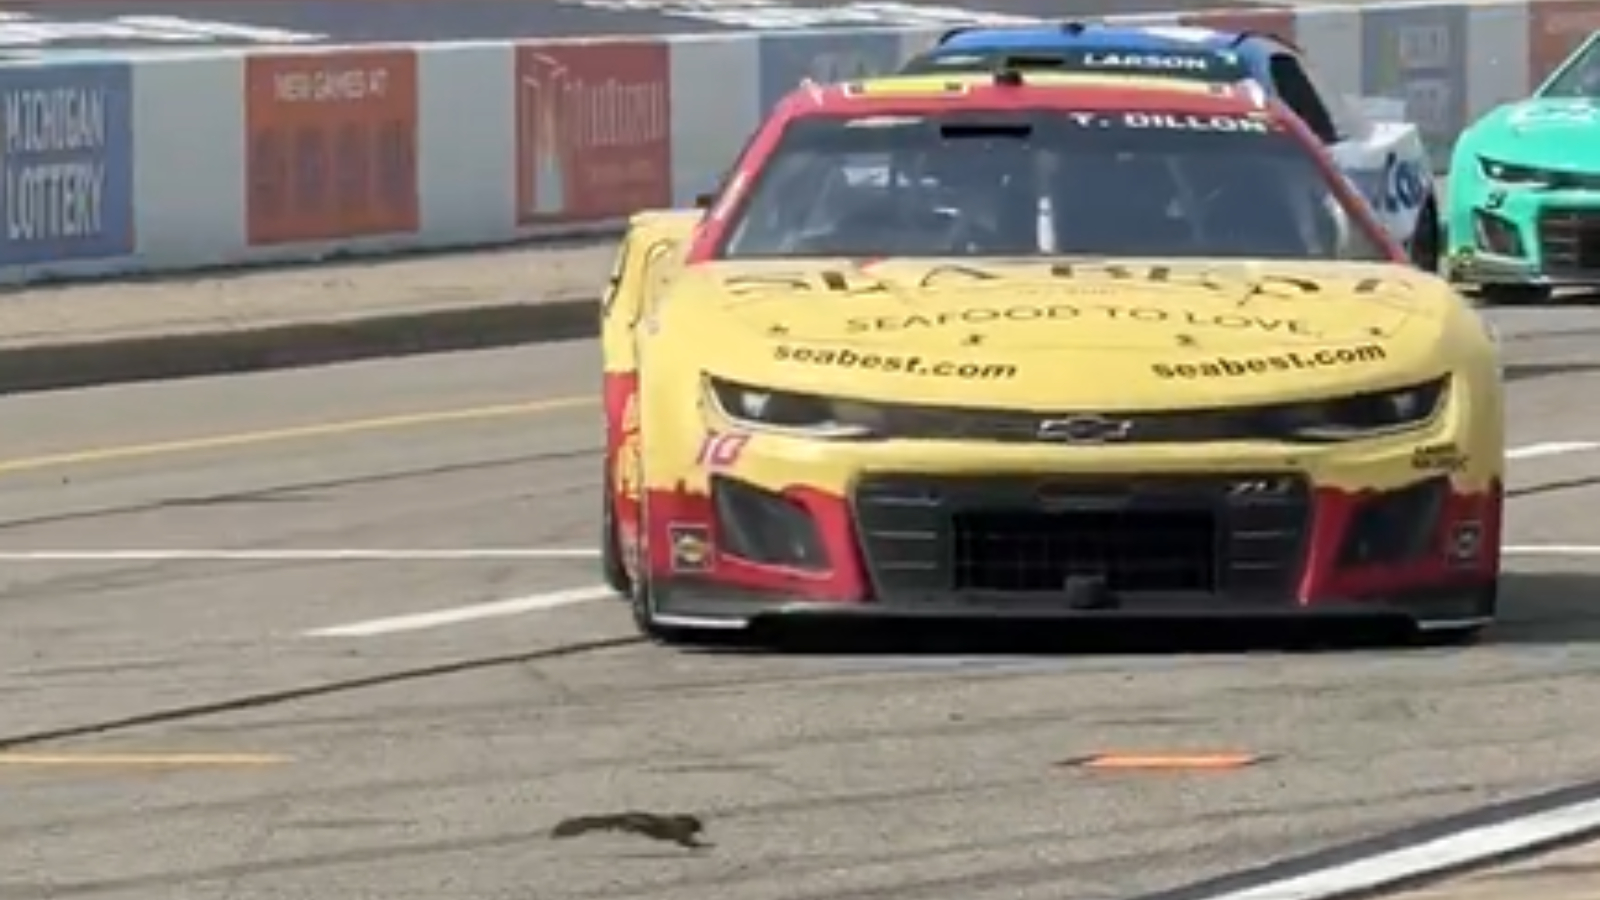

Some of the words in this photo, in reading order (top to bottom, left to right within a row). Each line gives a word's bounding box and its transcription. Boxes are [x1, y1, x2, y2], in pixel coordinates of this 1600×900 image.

[1083, 51, 1207, 71] LARSON
[313, 70, 364, 101] GAMES
[6, 86, 105, 152] MICHIGAN
[1070, 111, 1111, 128] T.
[1123, 111, 1268, 135] DILLON
[6, 163, 104, 239] LOTTERY
[846, 304, 1081, 334] SEAFOOD
[1106, 303, 1169, 322] TO
[771, 343, 1018, 381] seabest.com
[1150, 343, 1388, 380] seabest.com
